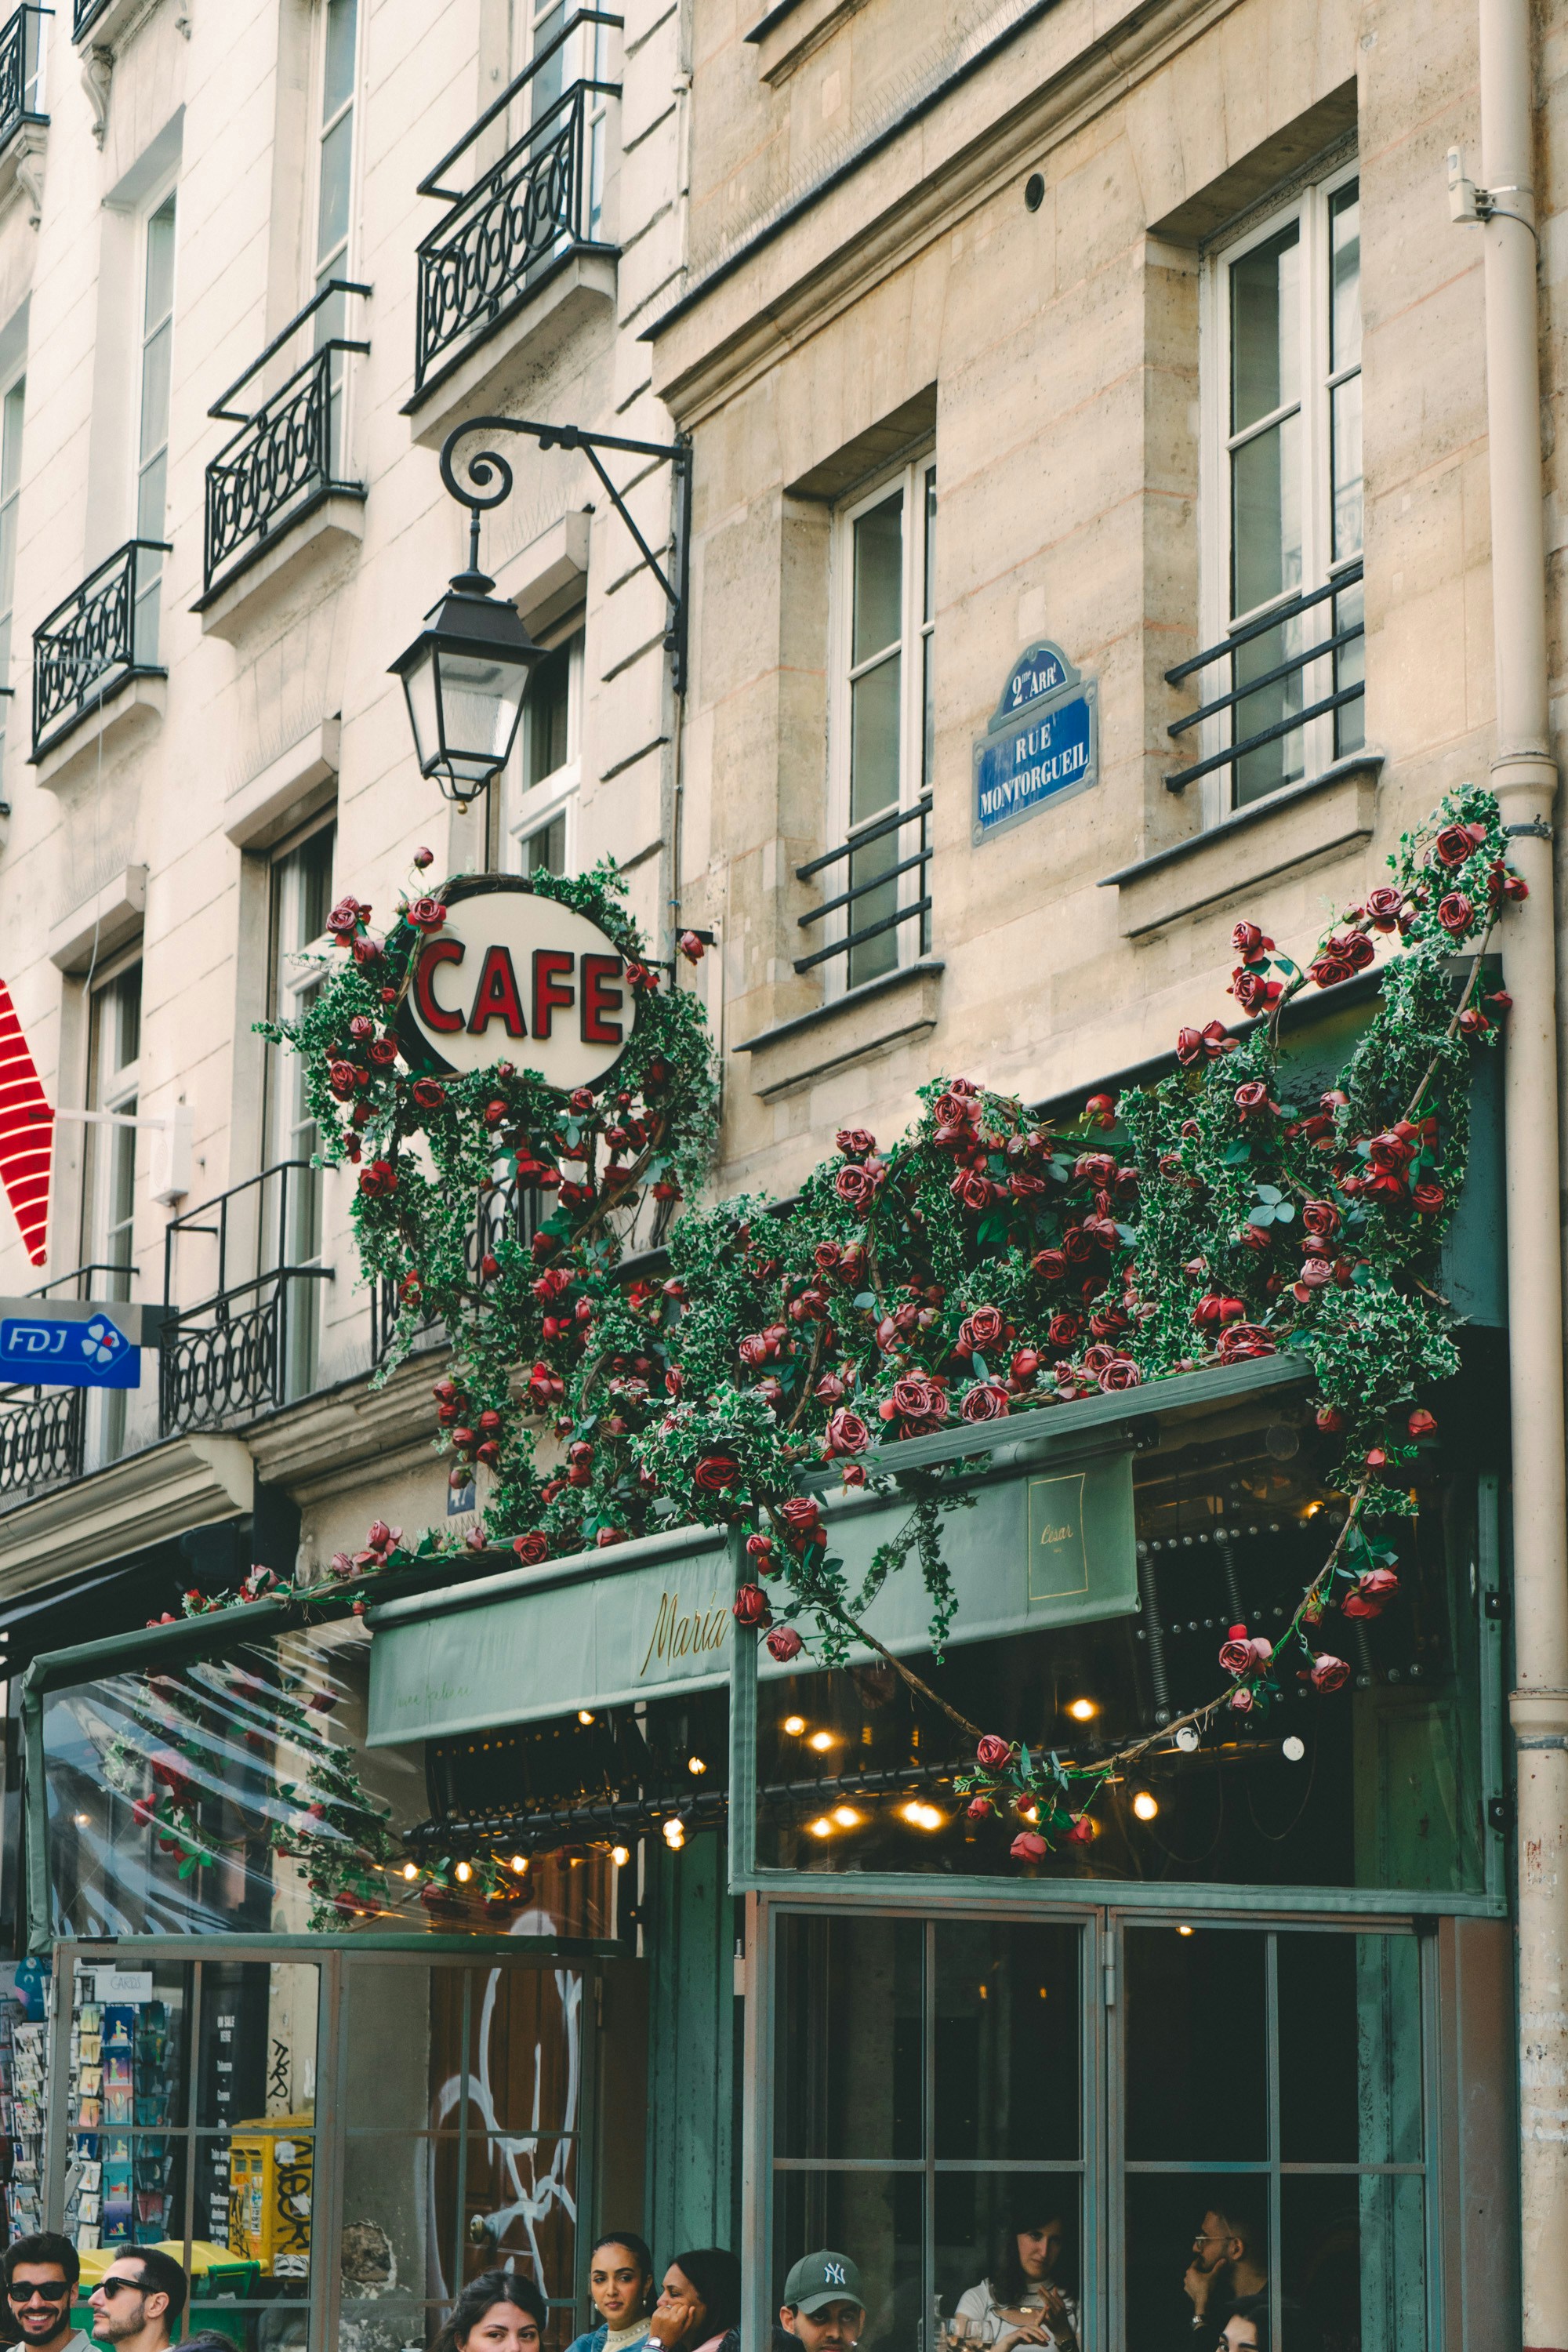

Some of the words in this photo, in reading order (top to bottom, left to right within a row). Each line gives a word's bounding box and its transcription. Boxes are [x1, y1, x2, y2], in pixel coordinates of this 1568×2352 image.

[1015, 724, 1051, 764] RUE
[981, 742, 1088, 818] MONTORGUEIL
[412, 938, 623, 1044] CAFE
[8, 1327, 67, 1353] FDJ
[824, 2263, 846, 2285] NY
